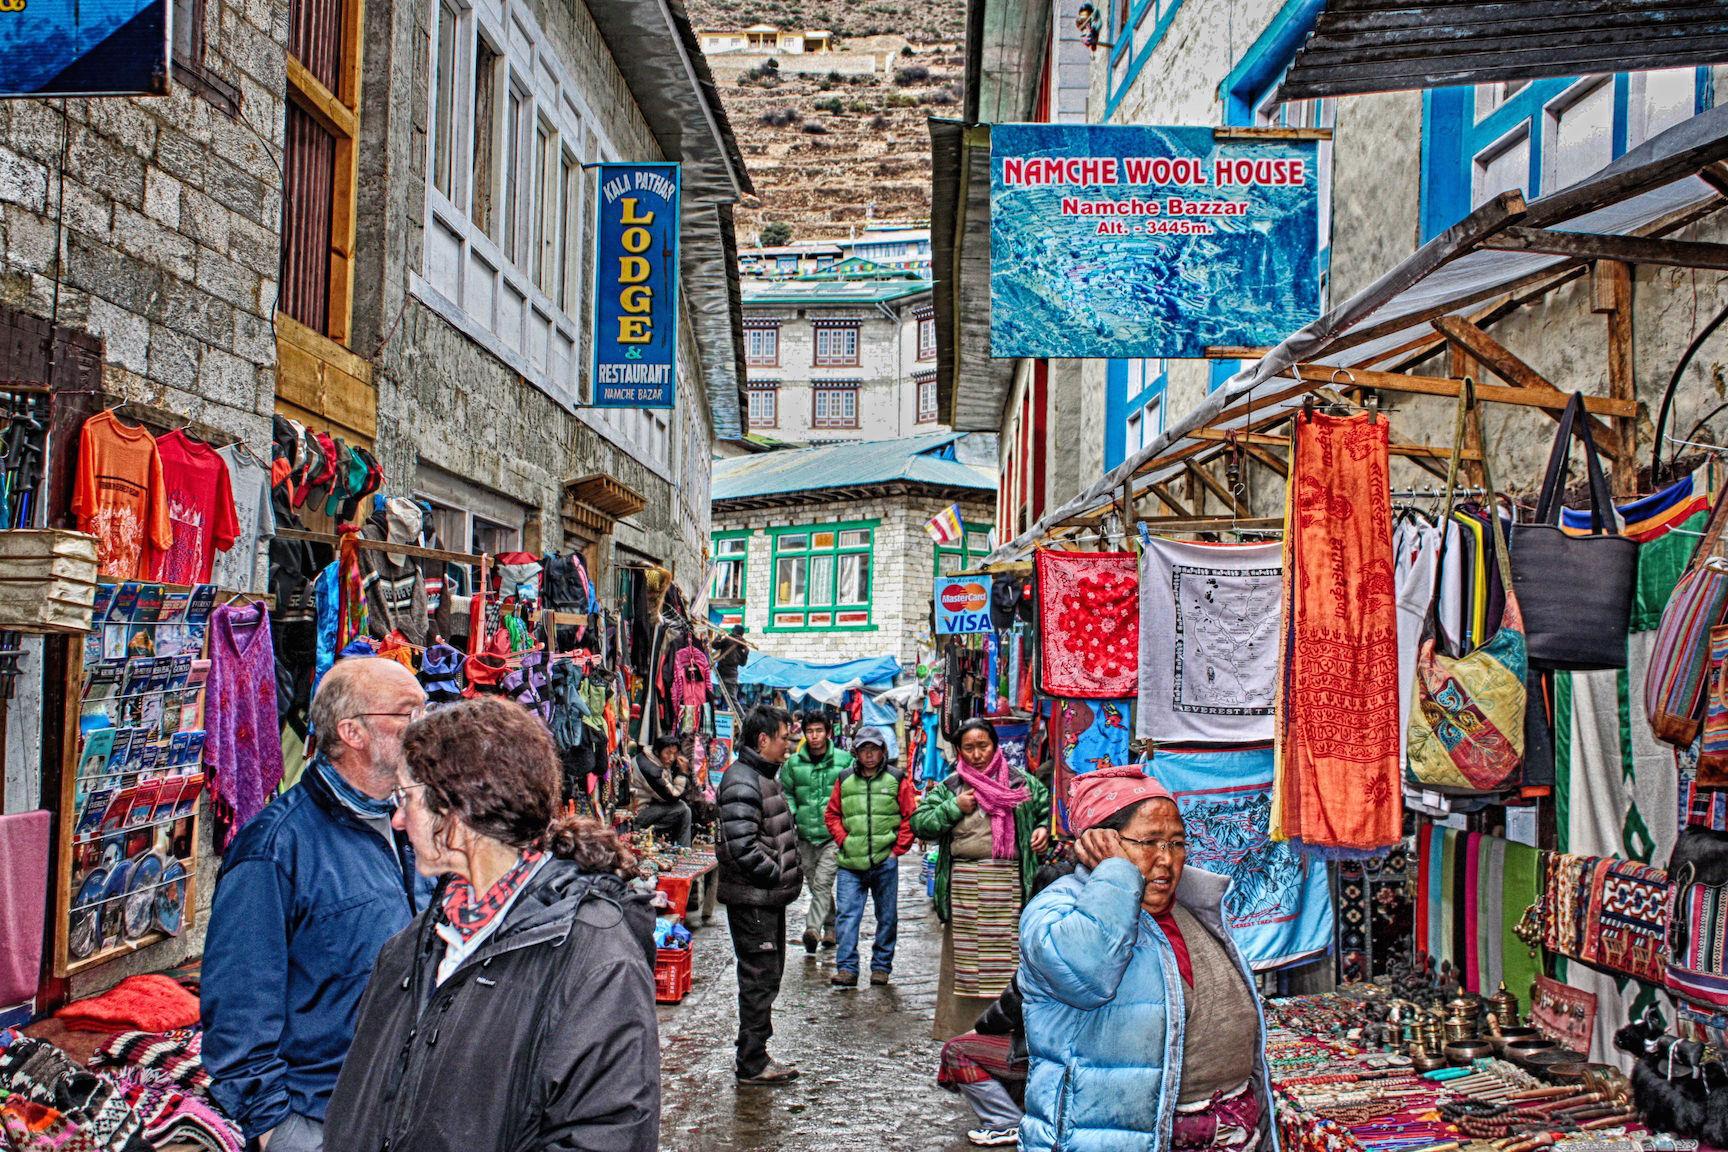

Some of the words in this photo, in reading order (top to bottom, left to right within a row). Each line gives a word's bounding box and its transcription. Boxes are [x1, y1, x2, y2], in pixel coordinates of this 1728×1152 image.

[1004, 159, 1117, 188] NAMCHE
[1126, 159, 1207, 186] WOOL
[1215, 159, 1306, 187] HOUSE
[603, 174, 632, 204] KALA
[635, 171, 676, 203] PATHAR
[1062, 199, 1160, 216] Namche
[1168, 199, 1249, 216] Bazzar
[1096, 221, 1130, 235] Alt.
[1146, 221, 1213, 235] 3445m.
[617, 197, 655, 344] LODGE
[625, 346, 642, 359] &
[599, 363, 671, 384] RESTAURANT
[604, 388, 635, 401] NAMCHE
[637, 388, 662, 401] BAZAR
[942, 592, 987, 603] MasterCard
[944, 613, 992, 632] VISA
[1183, 705, 1241, 716] EVEREST
